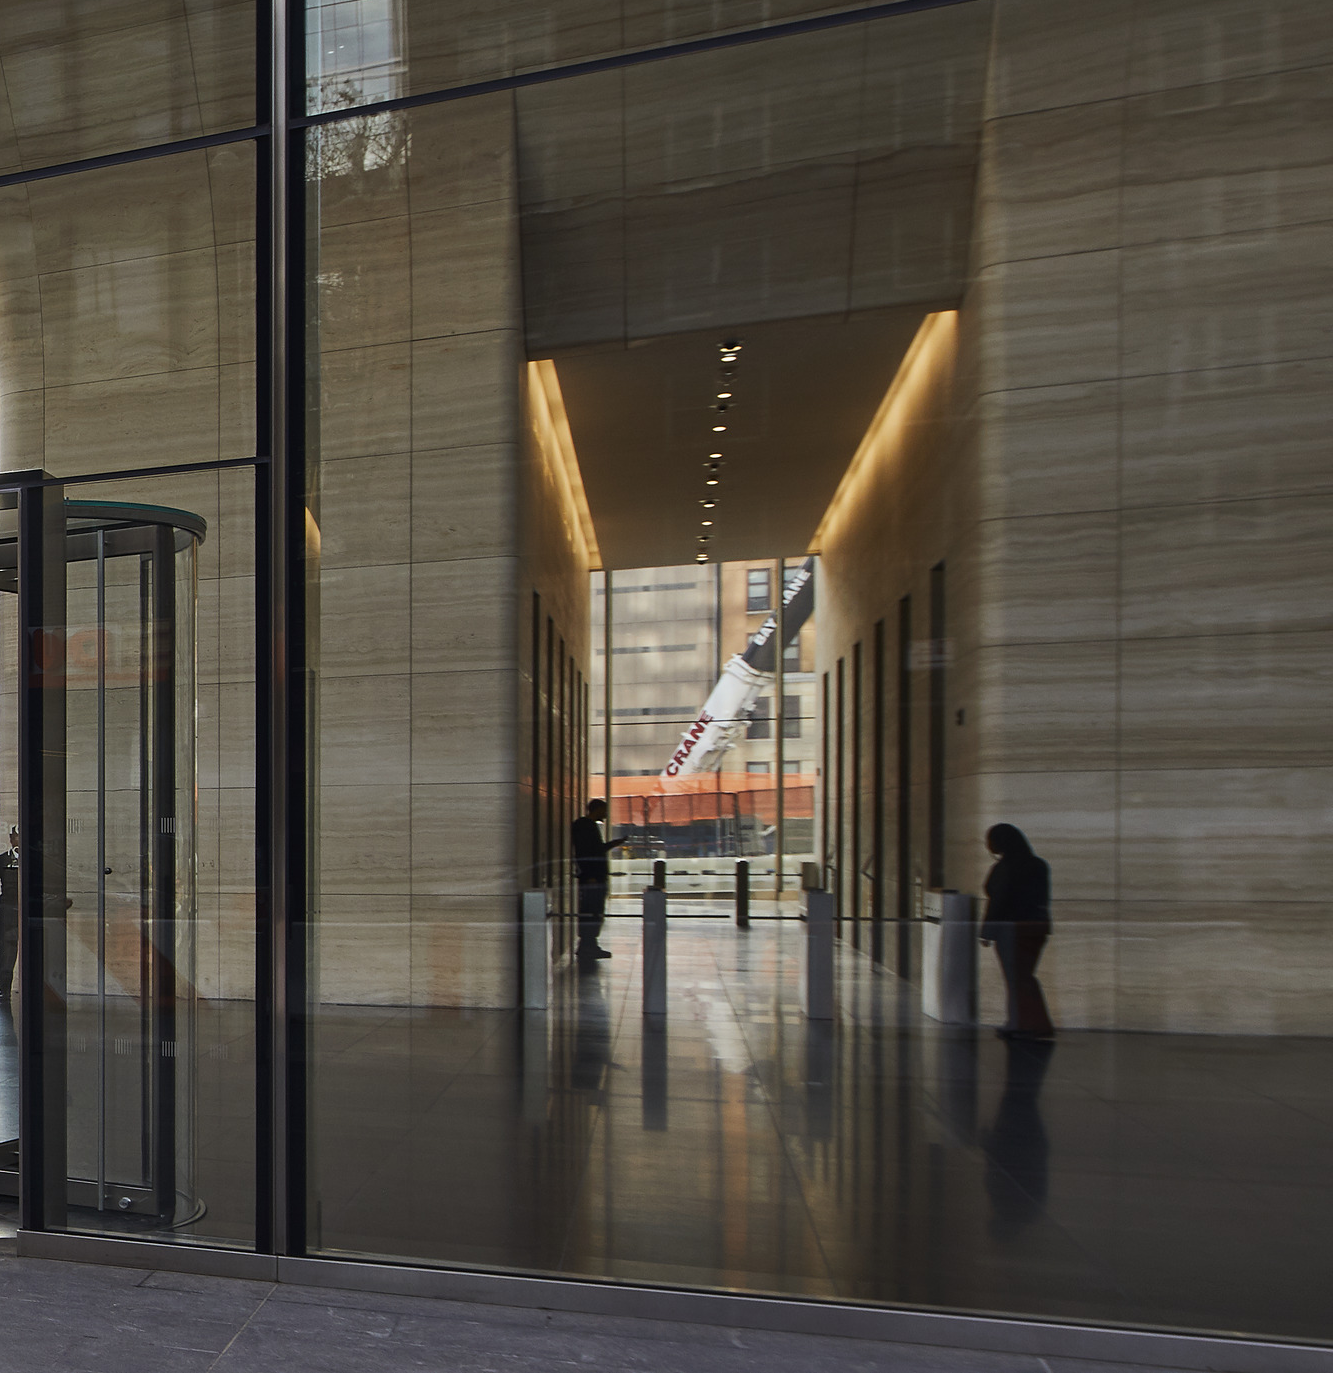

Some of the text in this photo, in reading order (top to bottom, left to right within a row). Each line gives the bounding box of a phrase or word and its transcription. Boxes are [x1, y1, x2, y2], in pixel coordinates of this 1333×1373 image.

[753, 569, 812, 647] BAY ANE
[666, 710, 715, 777] CRANE
